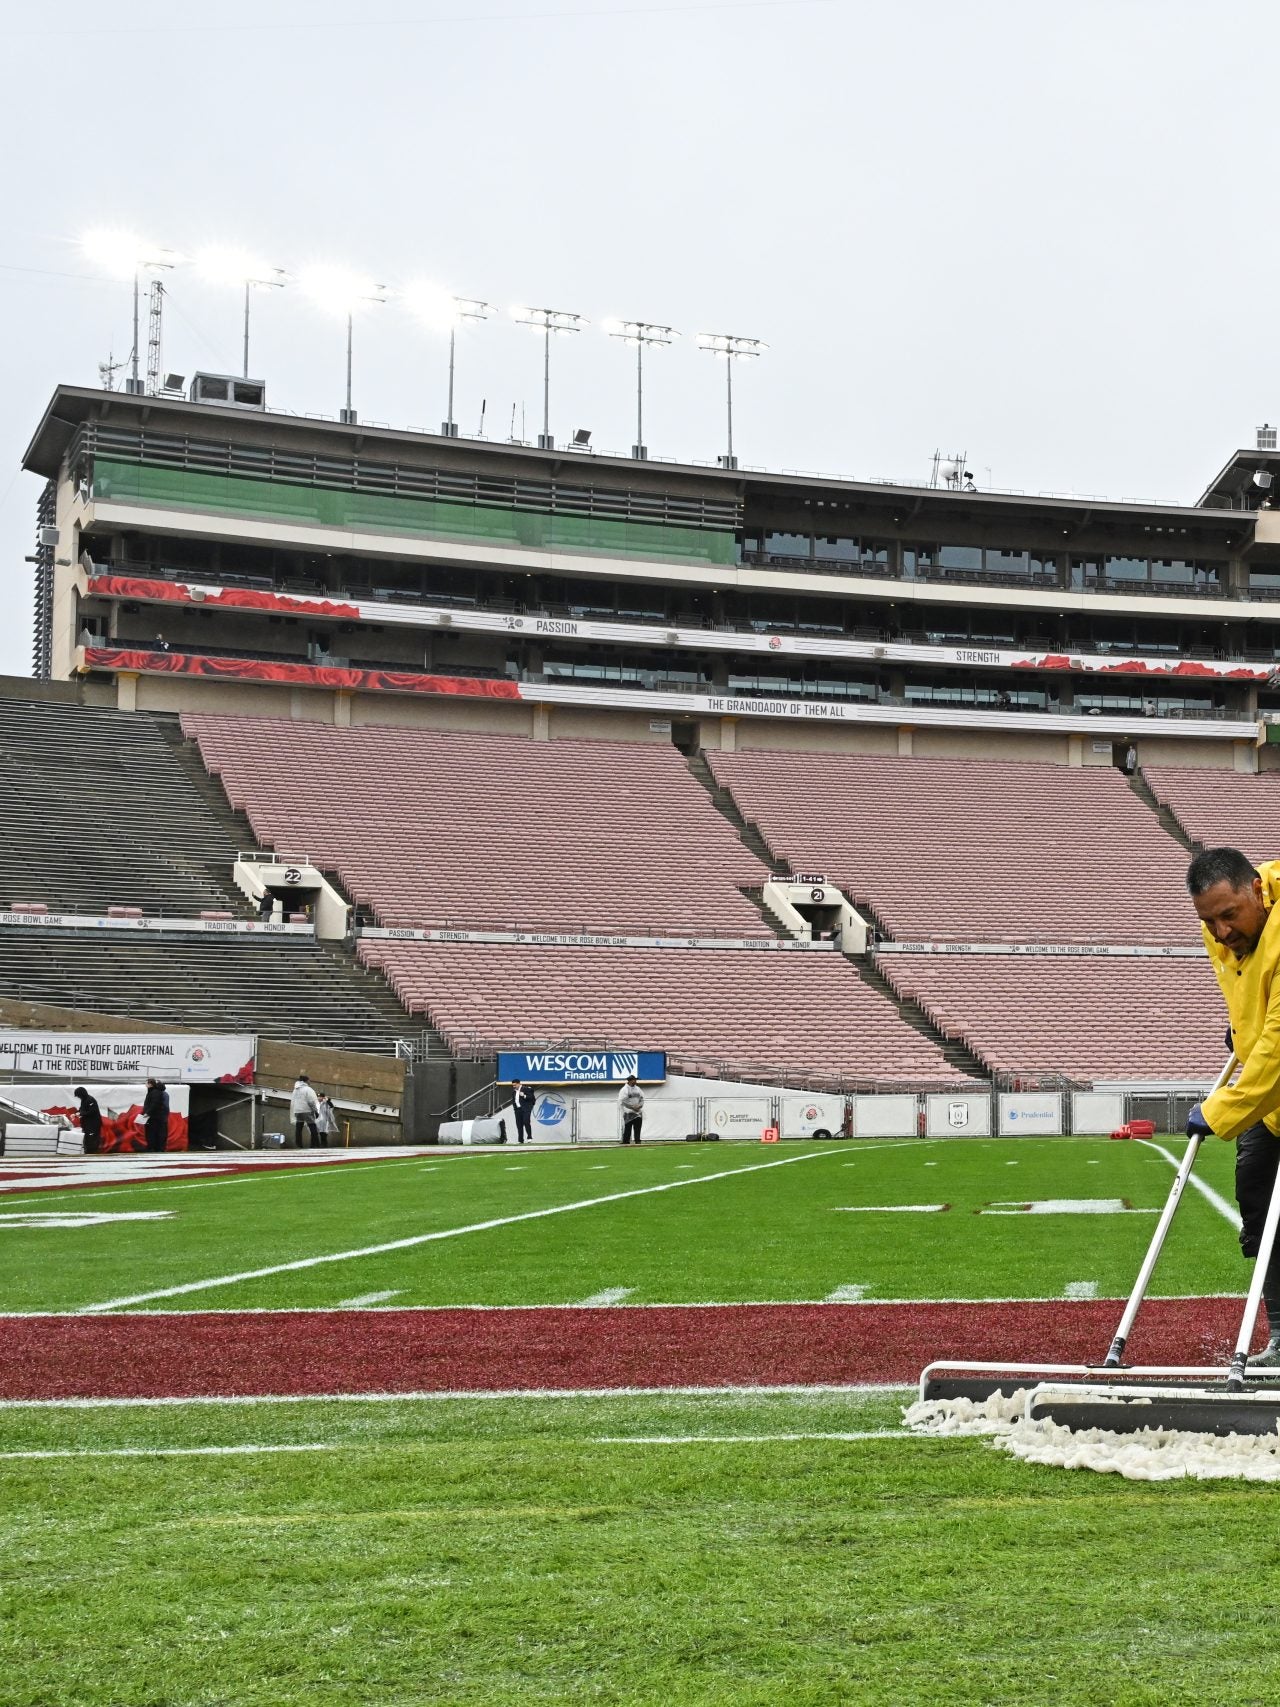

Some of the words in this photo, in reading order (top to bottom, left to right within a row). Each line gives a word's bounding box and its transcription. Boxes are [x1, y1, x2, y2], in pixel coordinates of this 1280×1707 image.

[536, 620, 578, 635] PASSION
[956, 650, 1000, 663] STRENGTH
[708, 698, 724, 711] THE
[727, 699, 787, 714] GRANDDADDY
[790, 702, 801, 715] OF
[804, 703, 828, 716] THEM
[829, 705, 845, 717] ALL
[286, 872, 301, 881] 22
[813, 891, 822, 900] 21
[3, 914, 20, 923] ROSE
[23, 915, 42, 924] BOWL
[44, 916, 62, 924] GAME
[204, 922, 237, 930] TRADITION
[264, 923, 286, 931] HONOR
[439, 931, 469, 939] STRENGTH
[580, 936, 594, 944] ROSE
[613, 937, 628, 945] GAME
[42, 1044, 52, 1054] TO
[56, 1044, 71, 1054] THE
[74, 1044, 111, 1055] PLAYOFF
[114, 1044, 174, 1056] QUARTERFINAL
[32, 1060, 42, 1071] AT
[46, 1060, 62, 1071] THE
[65, 1060, 87, 1071] ROSE
[90, 1060, 113, 1071] BOWL
[117, 1061, 140, 1071] GAME
[525, 1054, 607, 1071] WESCOM
[564, 1071, 607, 1079] Financial
[765, 1129, 774, 1141] G
